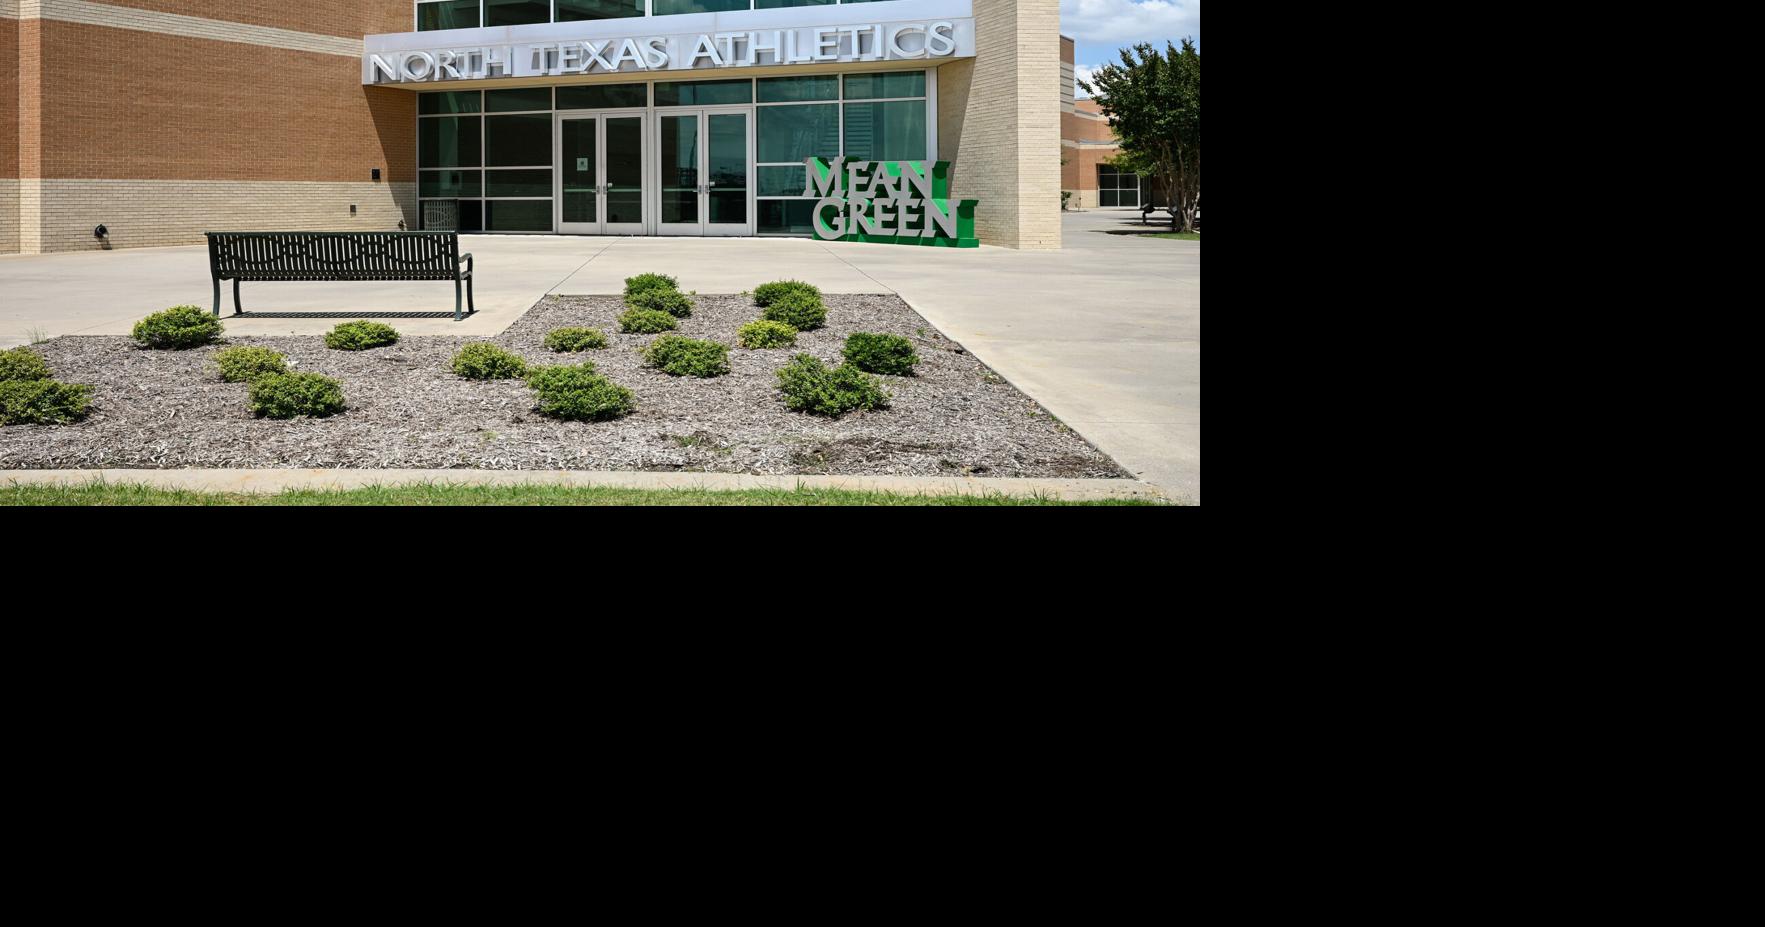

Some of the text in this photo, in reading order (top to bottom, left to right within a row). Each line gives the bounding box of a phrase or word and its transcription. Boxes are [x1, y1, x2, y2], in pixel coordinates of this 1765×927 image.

[369, 21, 956, 82] NORTH TEXAS ATHLETICS
[802, 156, 938, 199] MEAN
[812, 197, 962, 241] GREEN
